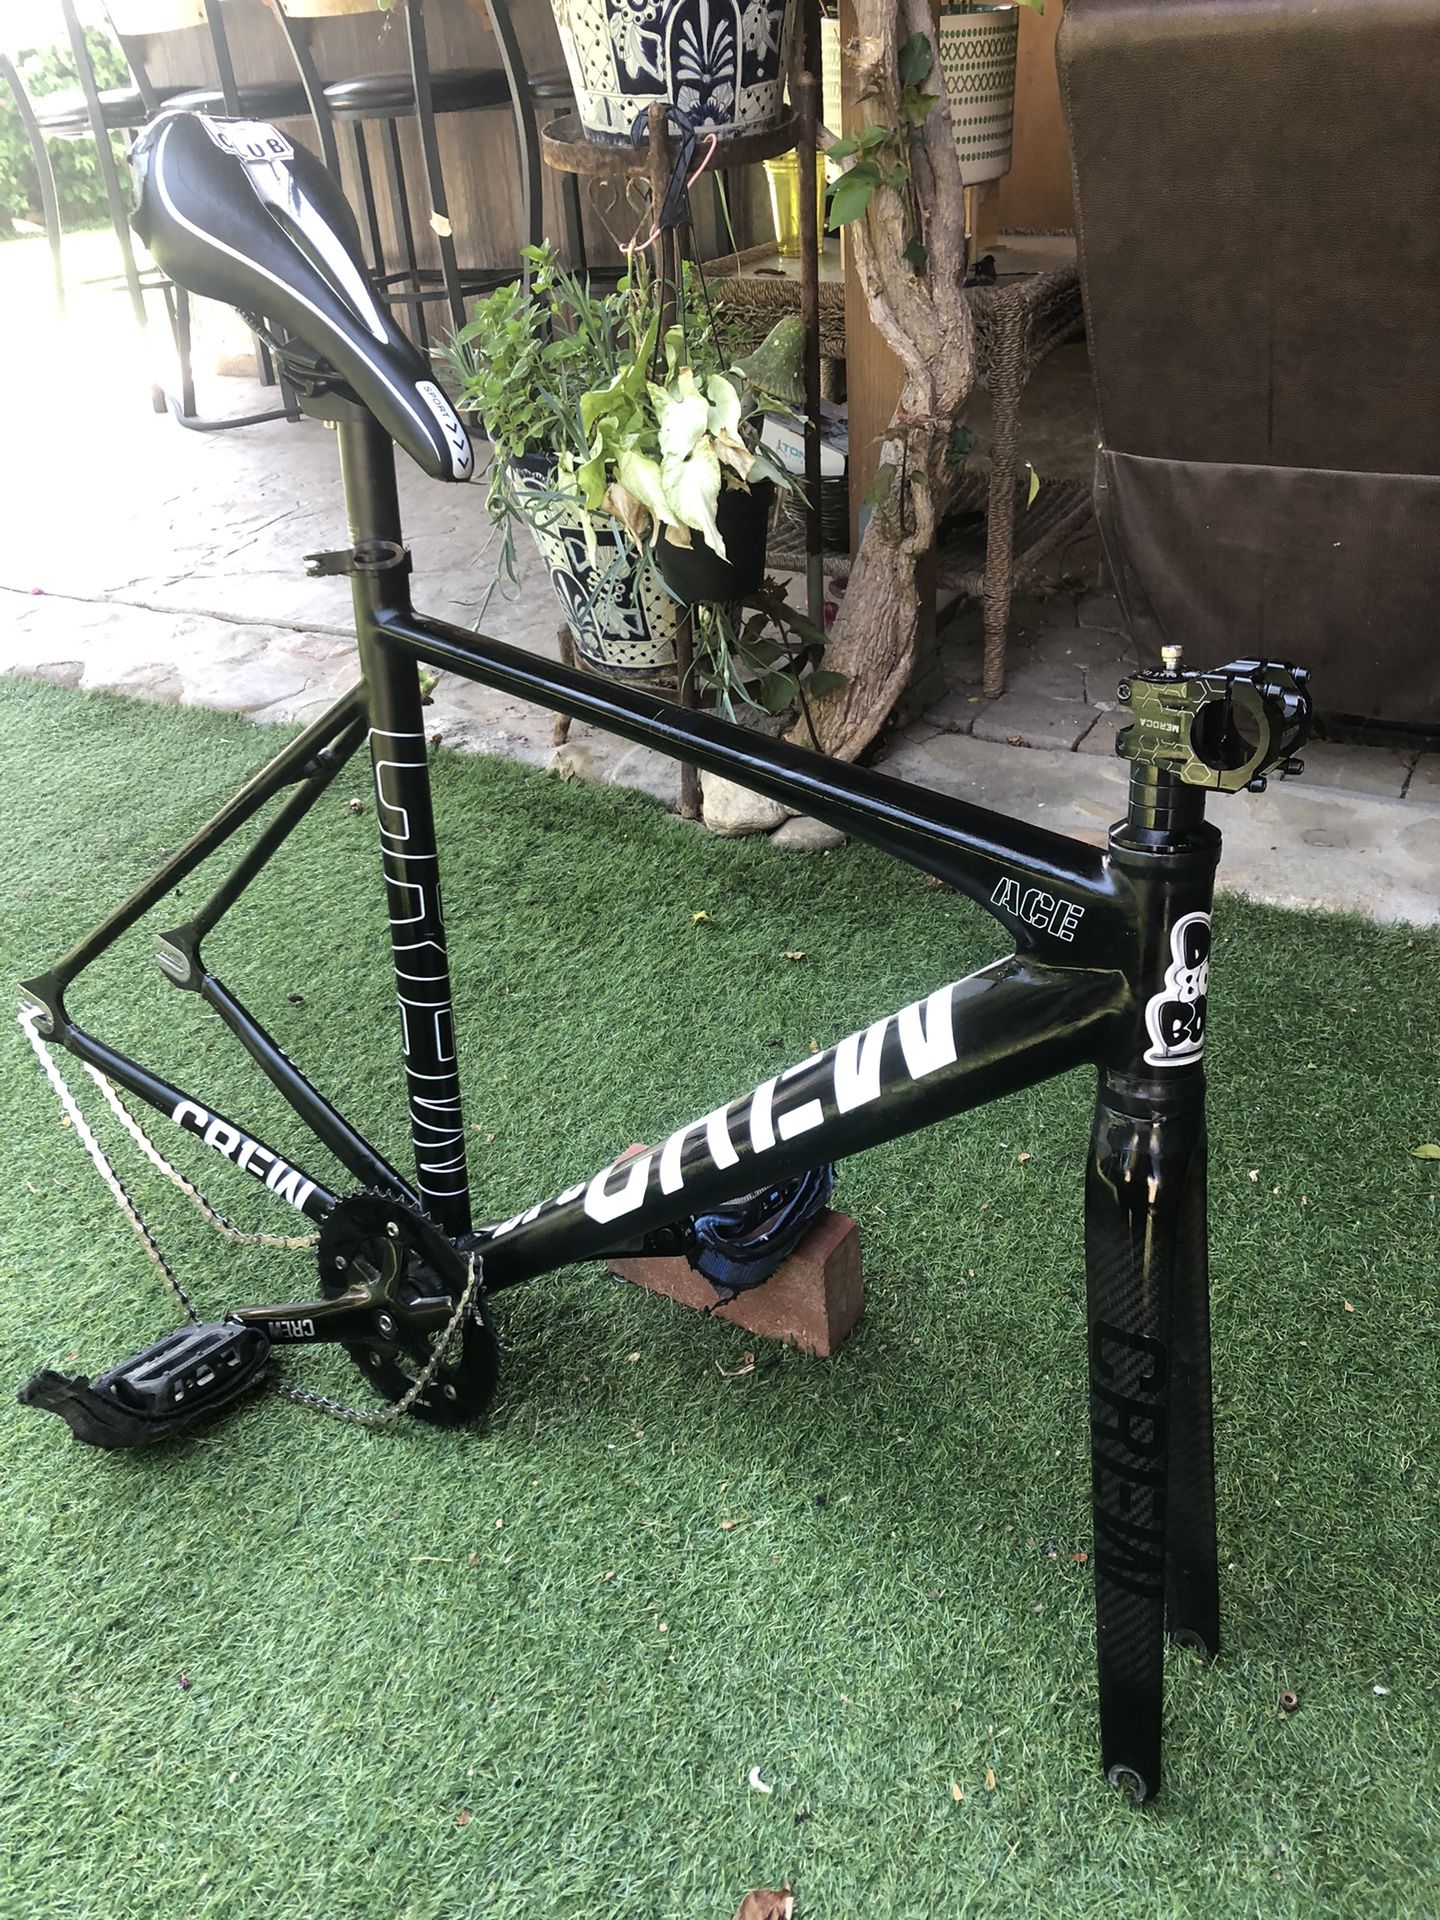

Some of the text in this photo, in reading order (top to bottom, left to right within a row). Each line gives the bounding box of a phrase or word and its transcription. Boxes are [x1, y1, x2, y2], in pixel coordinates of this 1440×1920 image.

[217, 132, 285, 158] CUB
[423, 385, 451, 418] SPORT
[1139, 718, 1180, 734] MEROCA
[990, 876, 1086, 943] ACE
[171, 1100, 318, 1212] CREW
[267, 1318, 316, 1338] CREW
